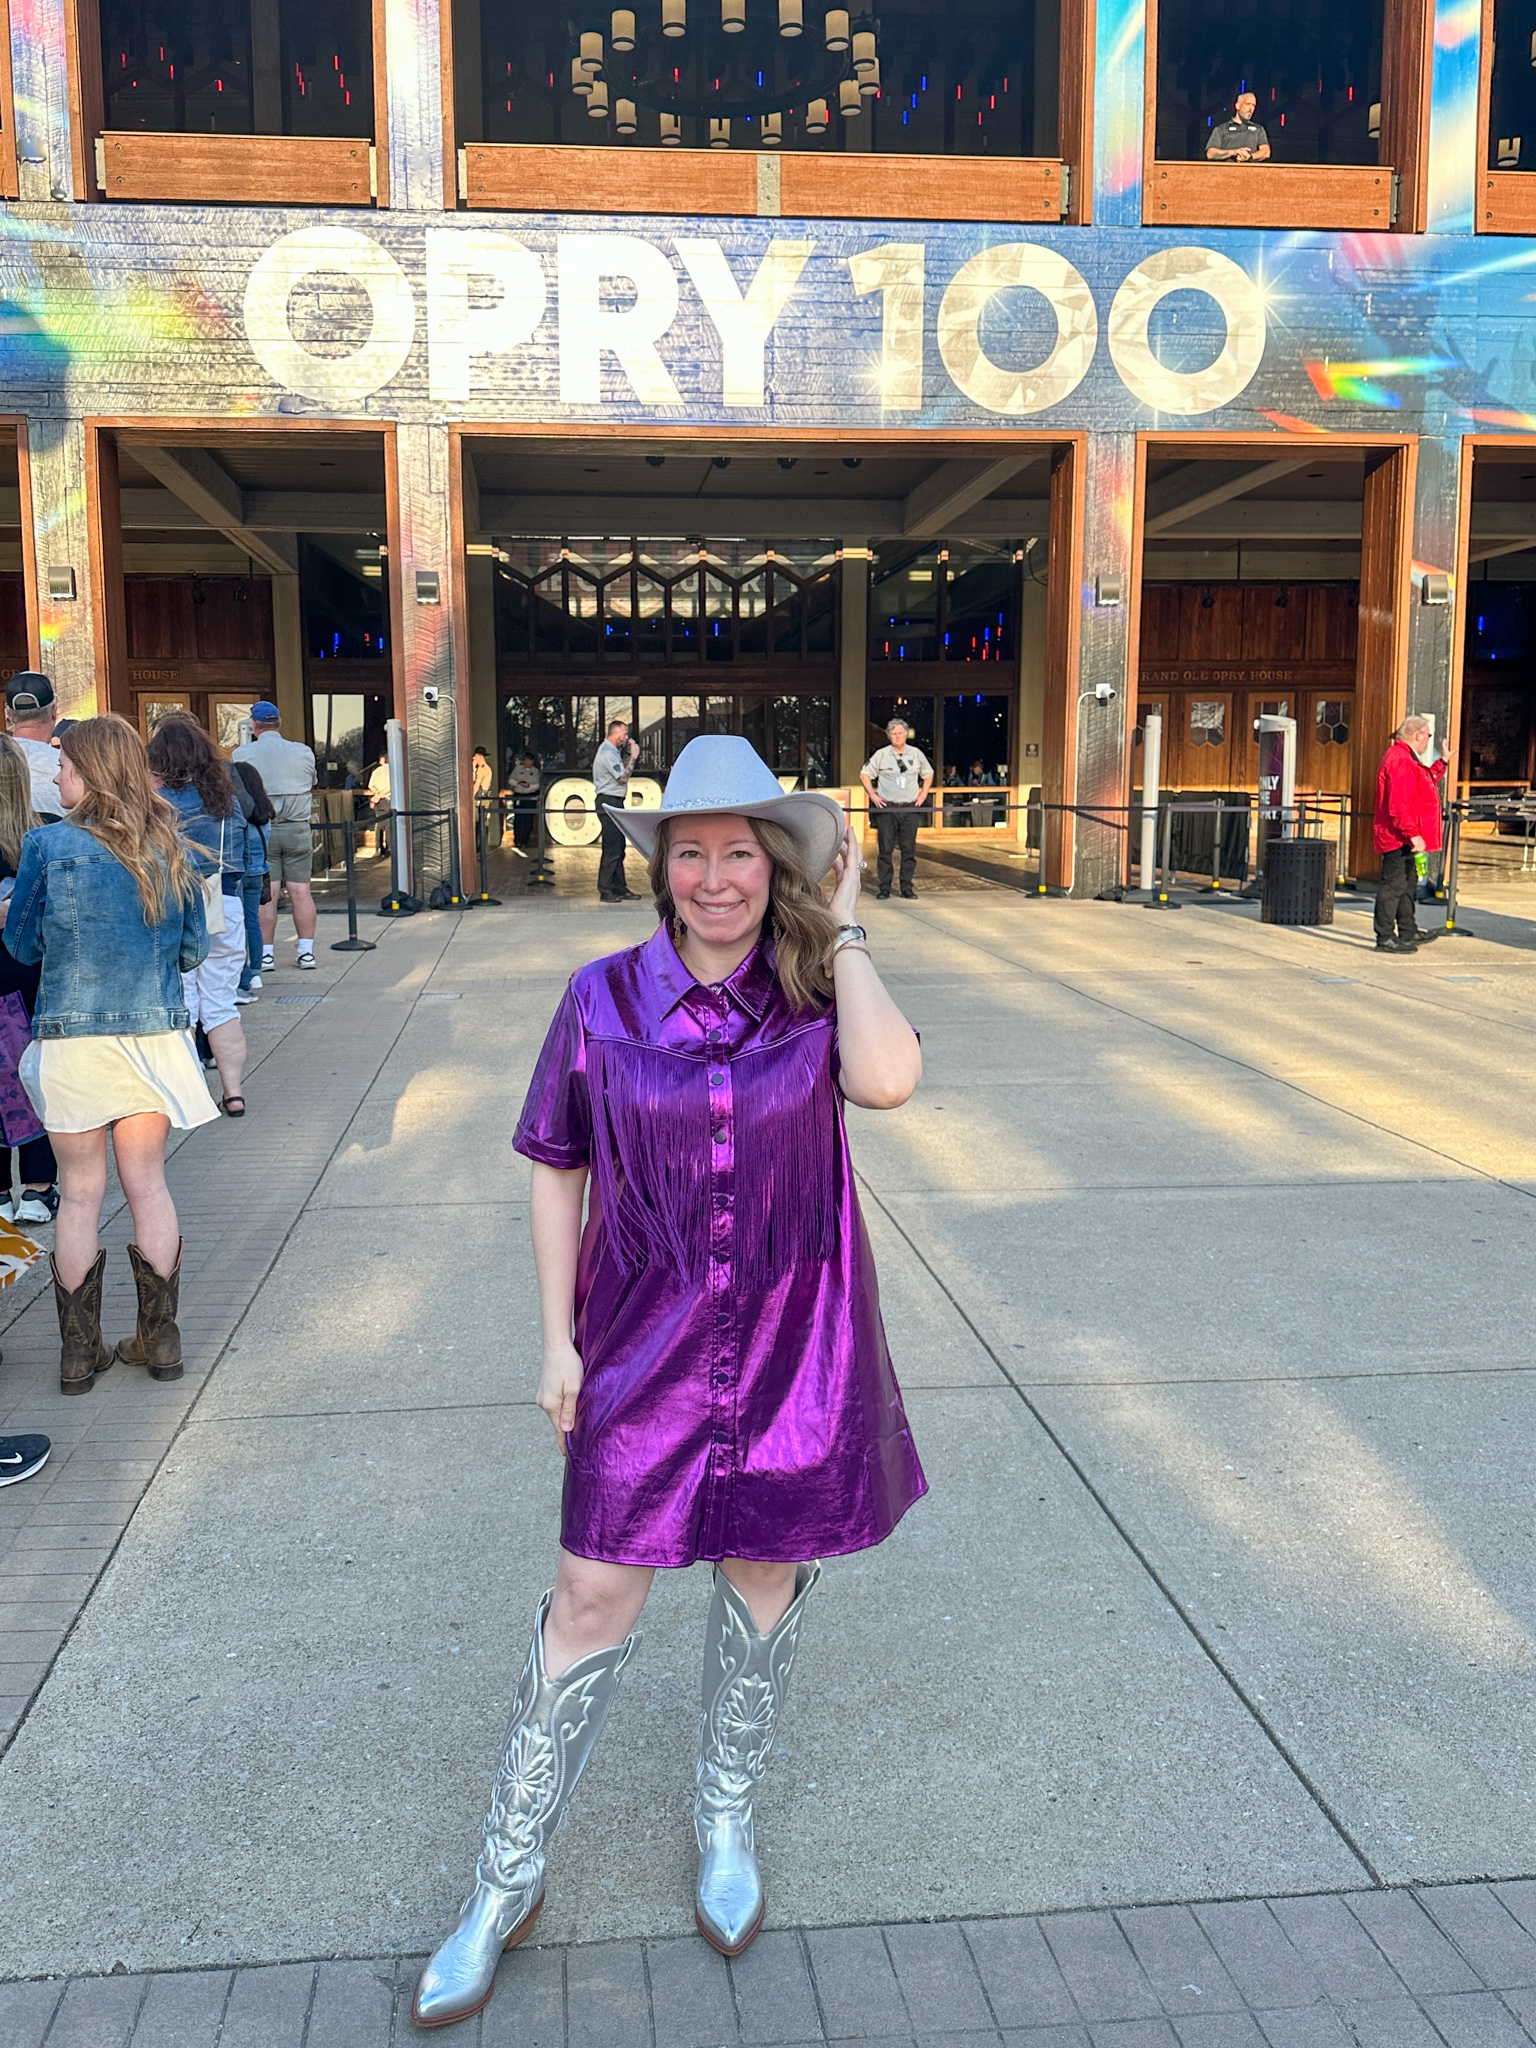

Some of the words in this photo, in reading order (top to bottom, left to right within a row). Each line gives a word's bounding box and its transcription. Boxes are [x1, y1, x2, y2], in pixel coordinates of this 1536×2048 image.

[244, 226, 816, 407] OPRY
[847, 243, 1266, 415] 100
[576, 566, 621, 592] OF
[132, 669, 179, 680] HOUSE
[1141, 670, 1179, 682] RAND
[1183, 670, 1209, 681] OLE
[1212, 670, 1245, 681] OPRY
[1250, 670, 1293, 681] HOUSE
